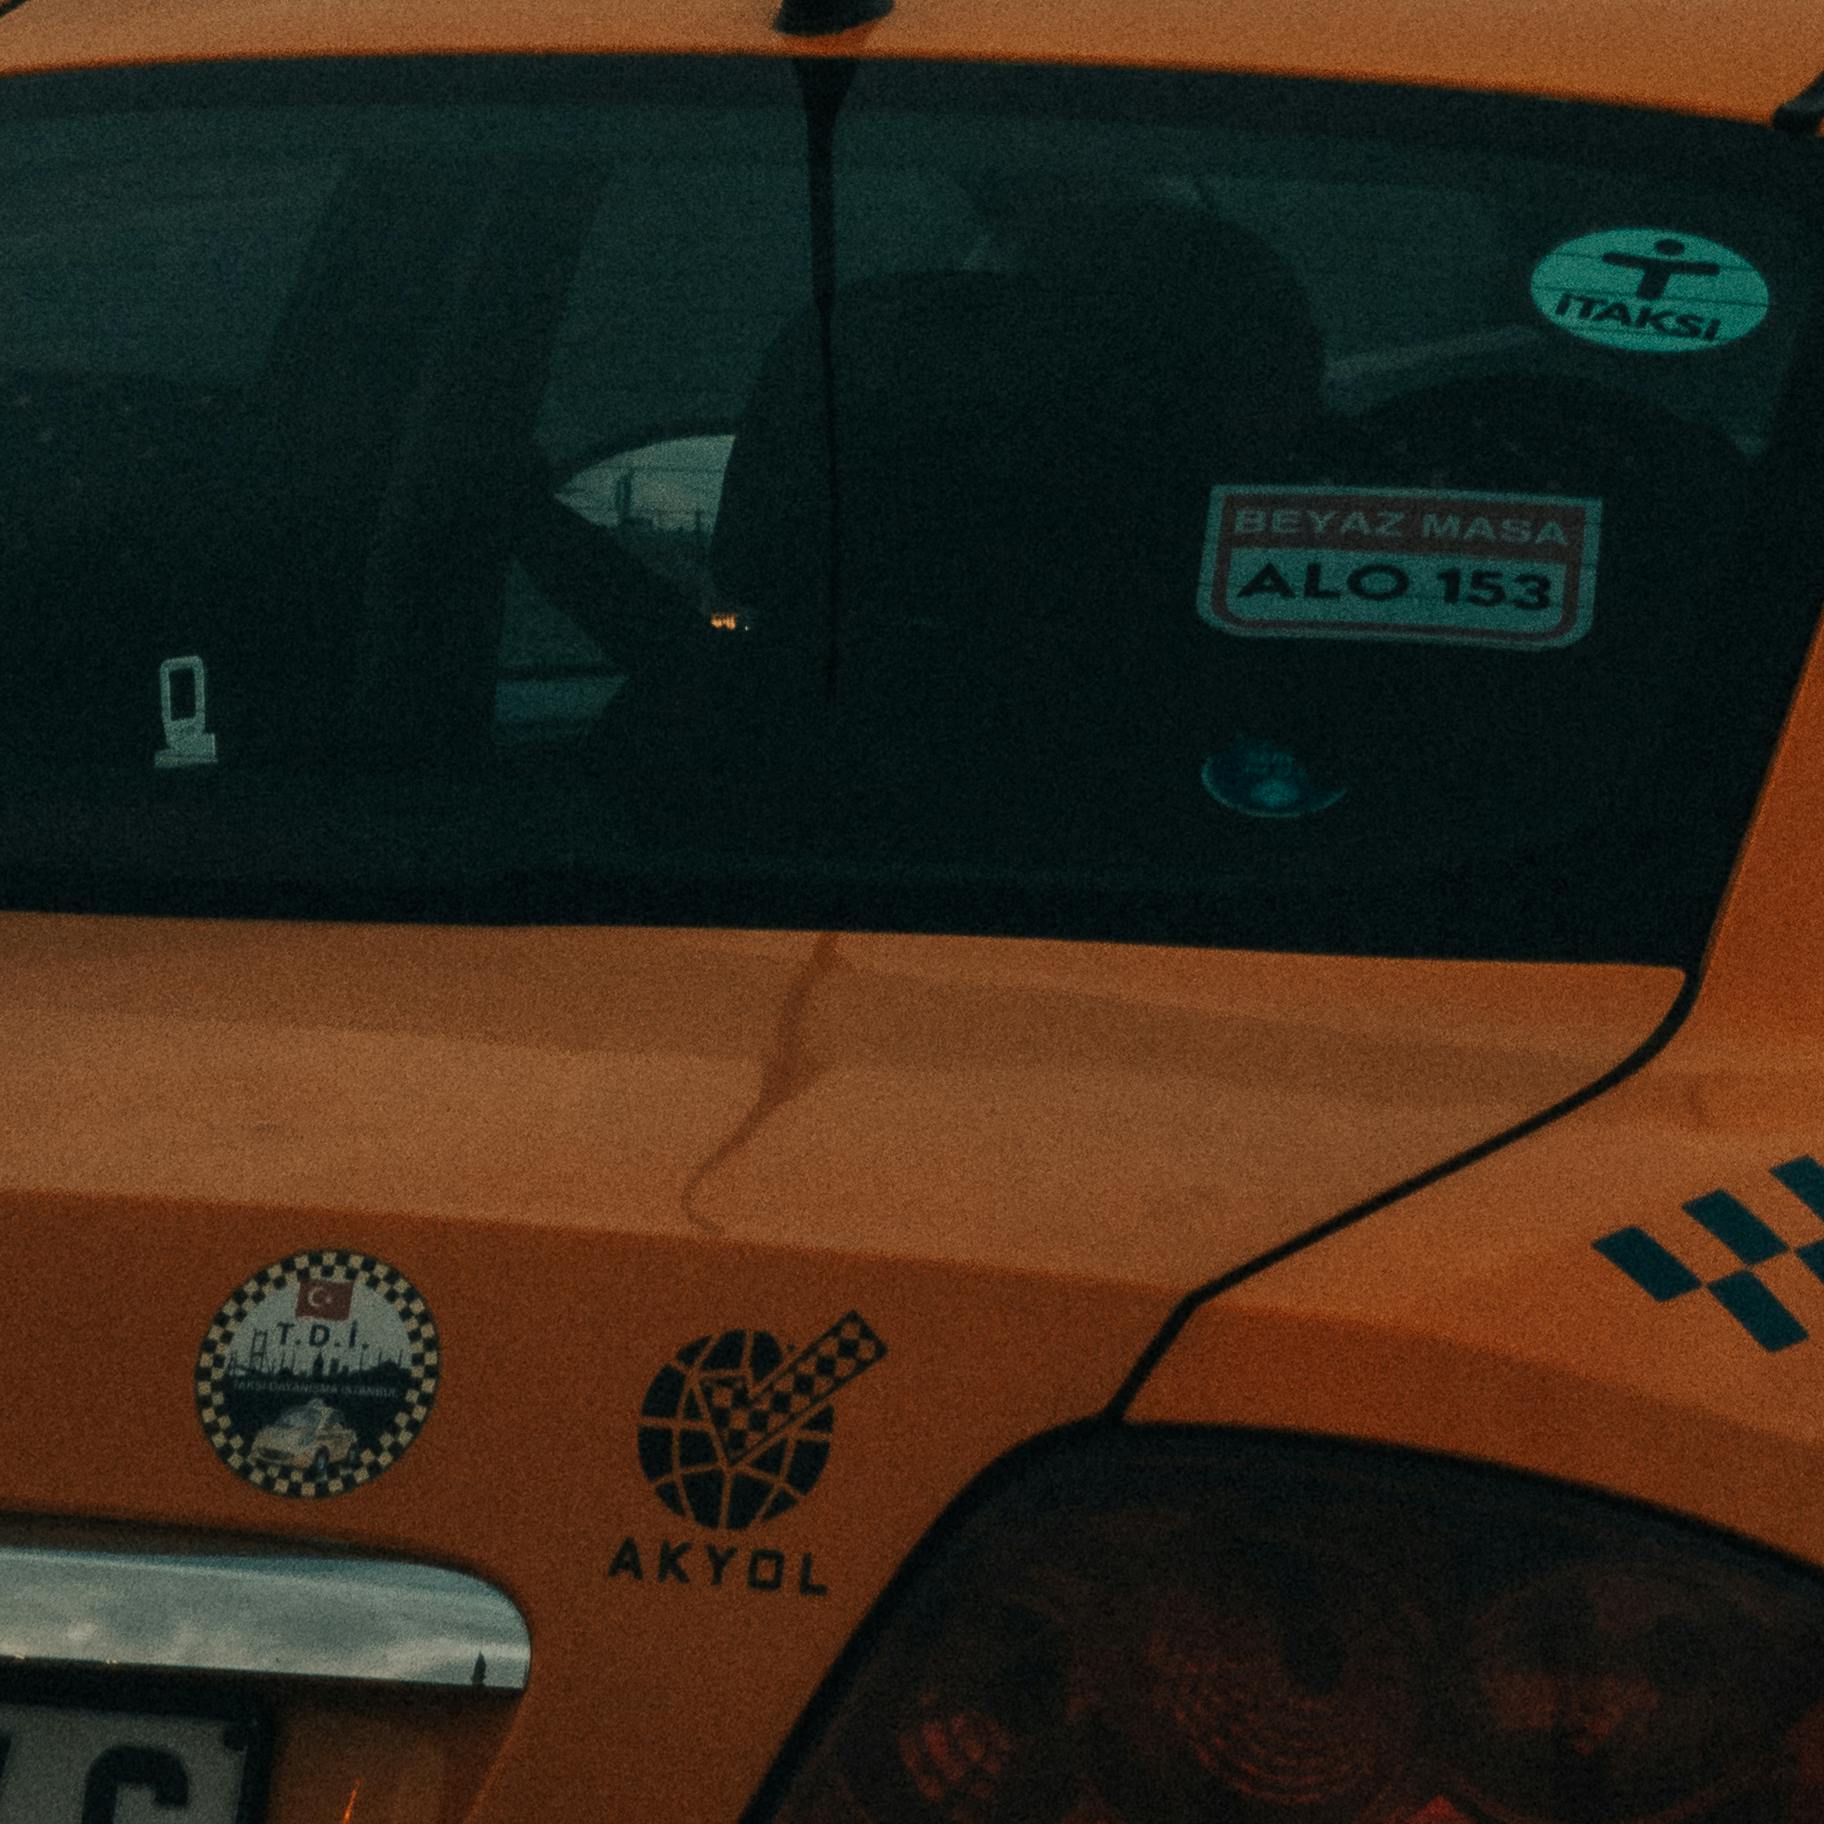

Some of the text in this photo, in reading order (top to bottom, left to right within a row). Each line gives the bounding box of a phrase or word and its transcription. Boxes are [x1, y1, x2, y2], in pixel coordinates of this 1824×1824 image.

[1233, 506, 1570, 548] BEYAZ MASA
[1236, 562, 1552, 611] ALO 153
[608, 1537, 829, 1597] AKYOL
